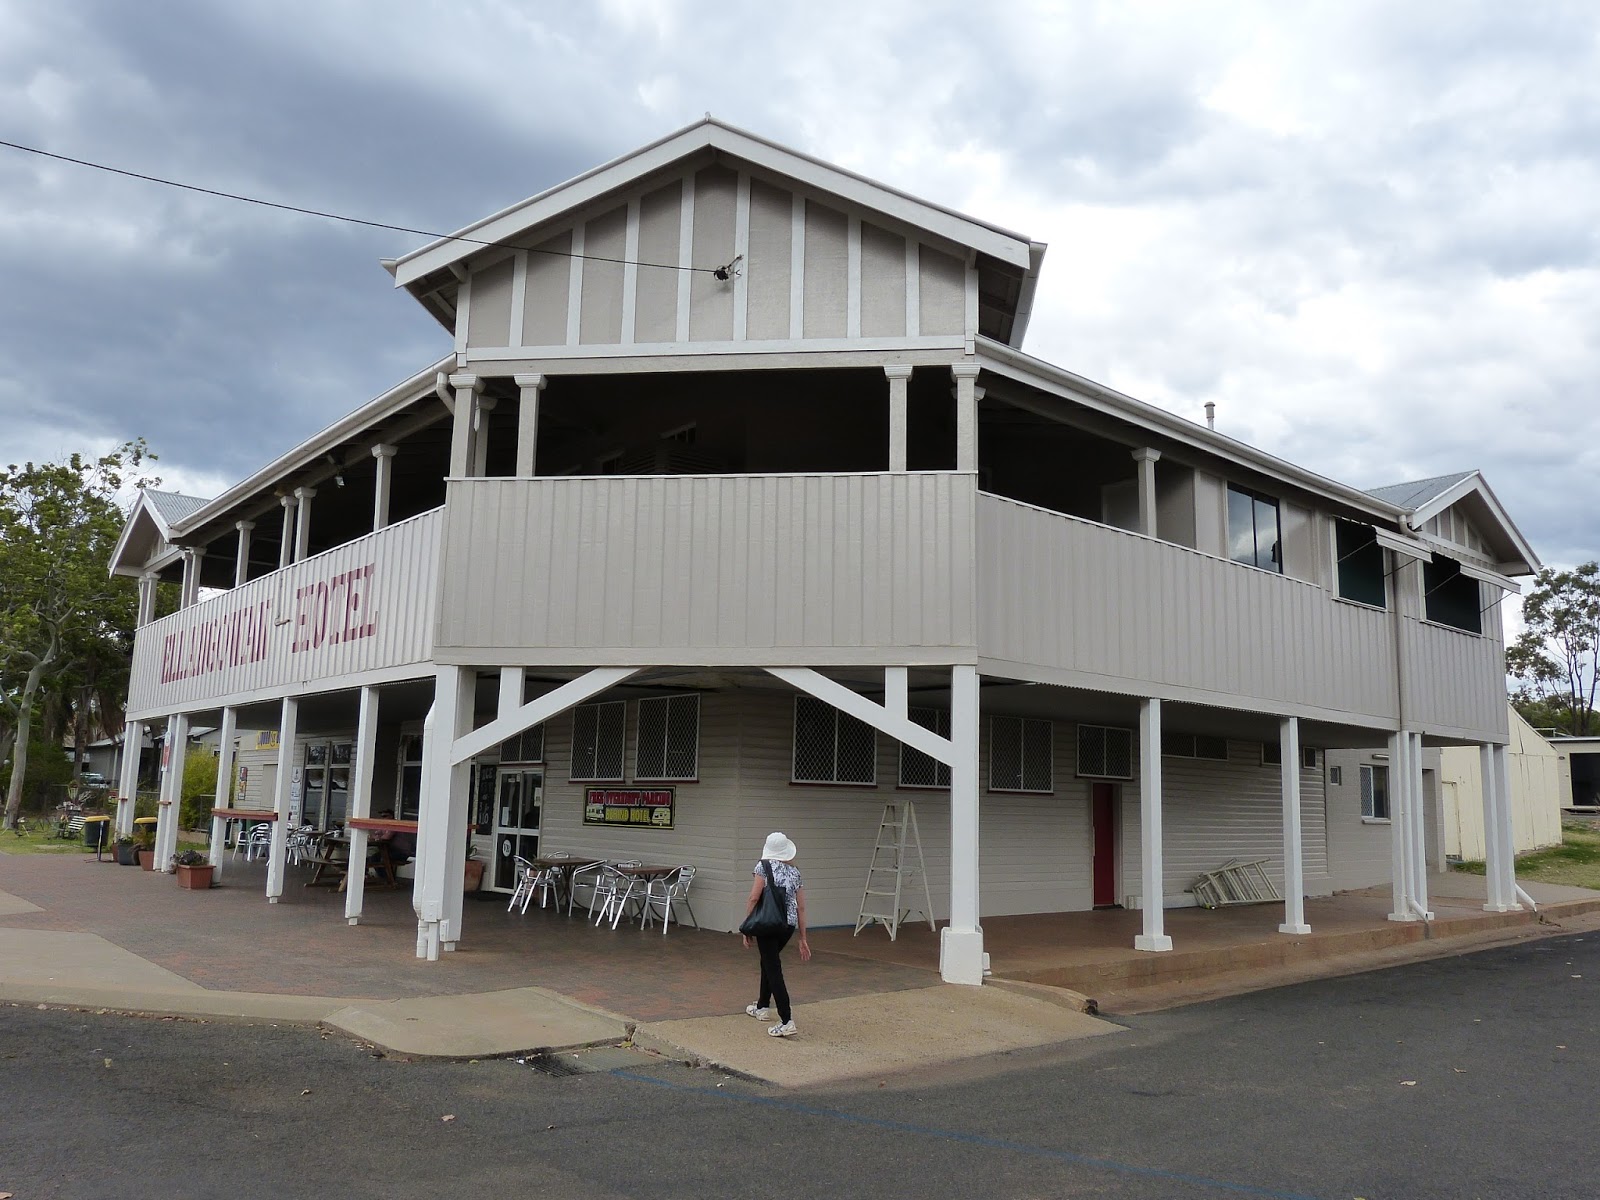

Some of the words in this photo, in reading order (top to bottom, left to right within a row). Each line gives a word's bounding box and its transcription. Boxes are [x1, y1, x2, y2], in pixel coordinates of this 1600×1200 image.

[292, 563, 378, 653] HOTEL
[605, 807, 629, 821] BEHIND
[630, 808, 651, 822] HOTEL
